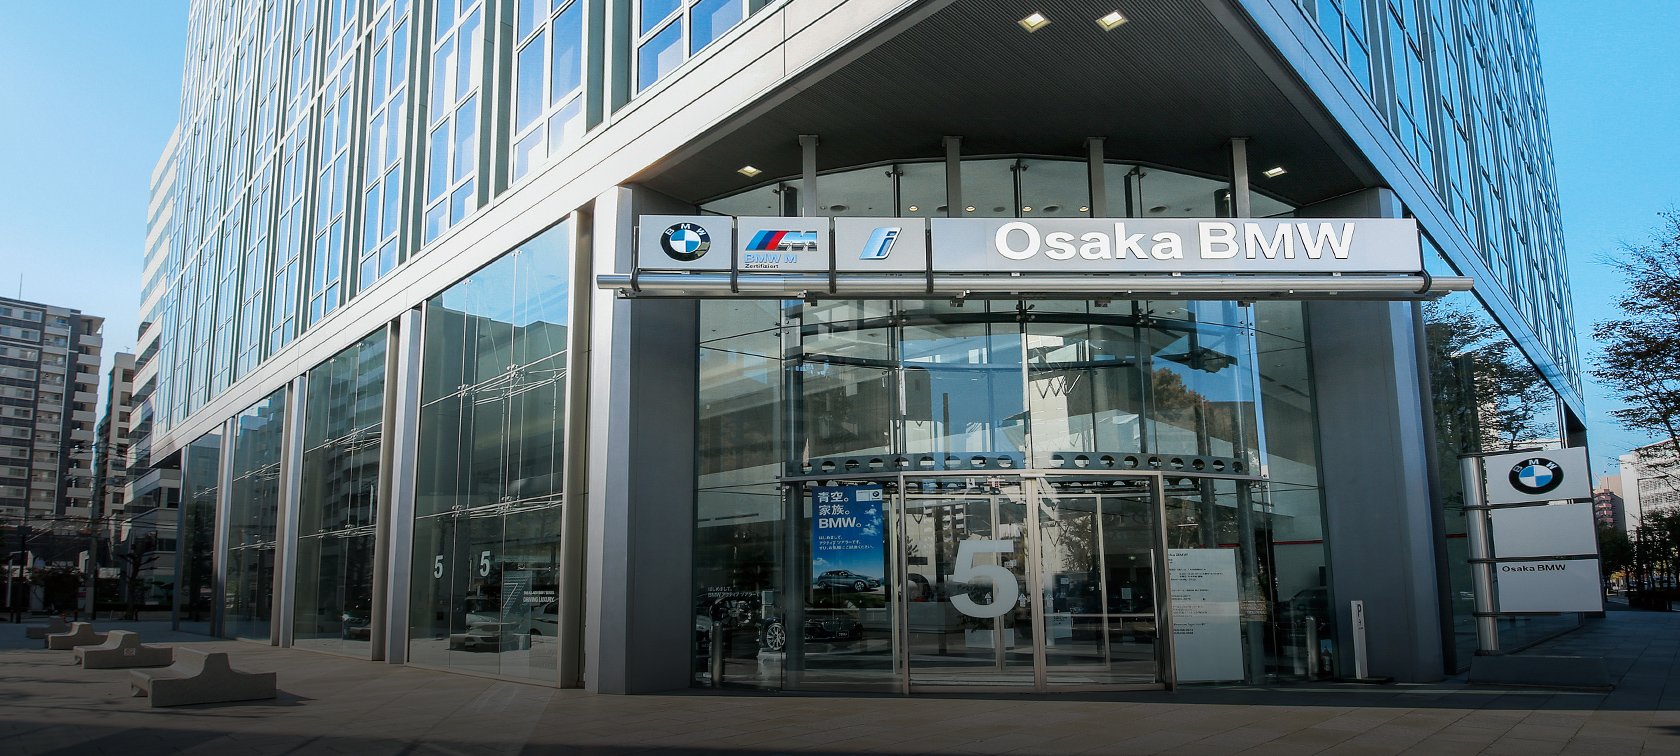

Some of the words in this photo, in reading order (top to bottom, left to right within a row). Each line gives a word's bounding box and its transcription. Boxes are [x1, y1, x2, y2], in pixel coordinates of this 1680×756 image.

[665, 223, 707, 237] BMW
[994, 221, 1184, 261] Osaka
[1198, 221, 1356, 261] BMW
[744, 253, 781, 264] BMW
[784, 253, 798, 264] M
[1512, 458, 1558, 473] BMW
[817, 491, 849, 503] 青空。
[818, 504, 850, 516] 家族。
[433, 555, 444, 579] 5
[480, 551, 491, 577] 5
[950, 540, 1019, 619] 5
[1357, 604, 1362, 617] P
